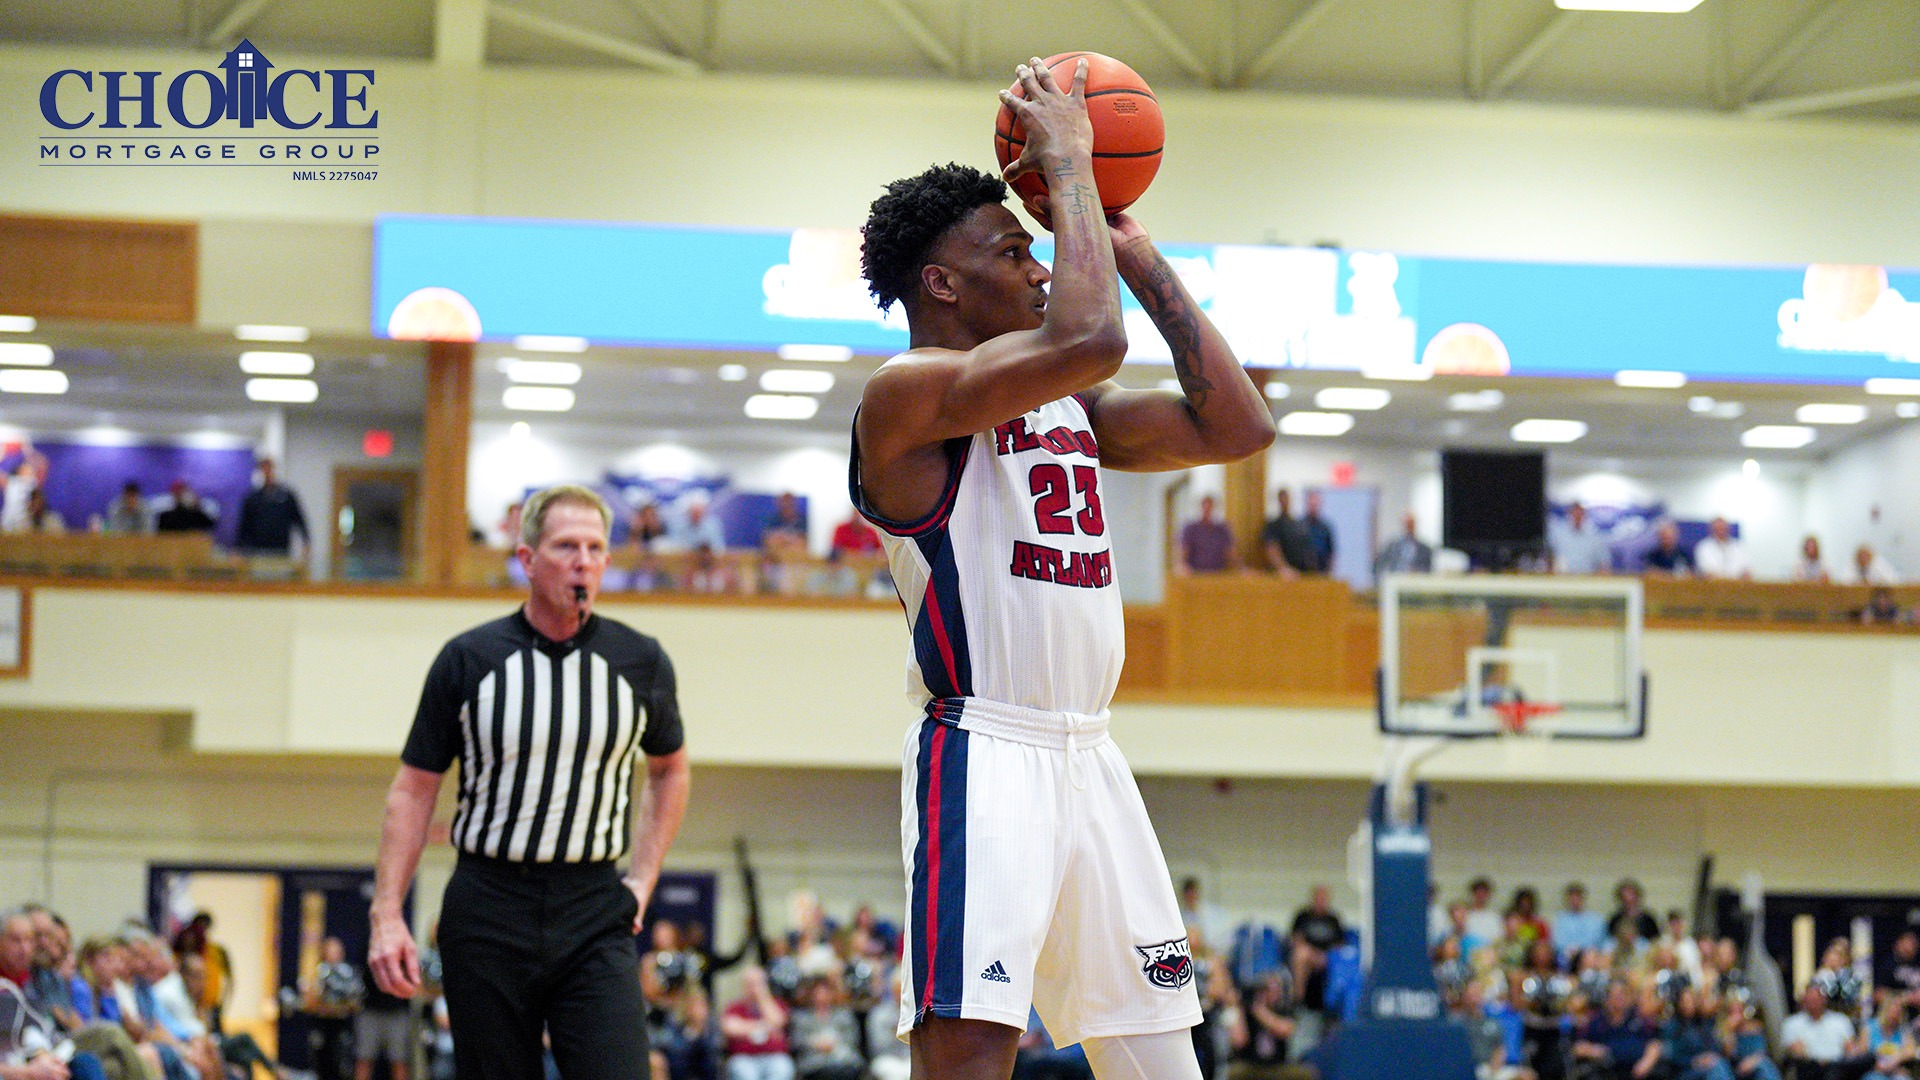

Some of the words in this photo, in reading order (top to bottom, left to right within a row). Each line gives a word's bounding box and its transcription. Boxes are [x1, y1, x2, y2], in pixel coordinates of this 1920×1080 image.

[1028, 463, 1105, 537] 23
[1010, 540, 1112, 589] ATLANT
[980, 972, 1011, 984] adidas
